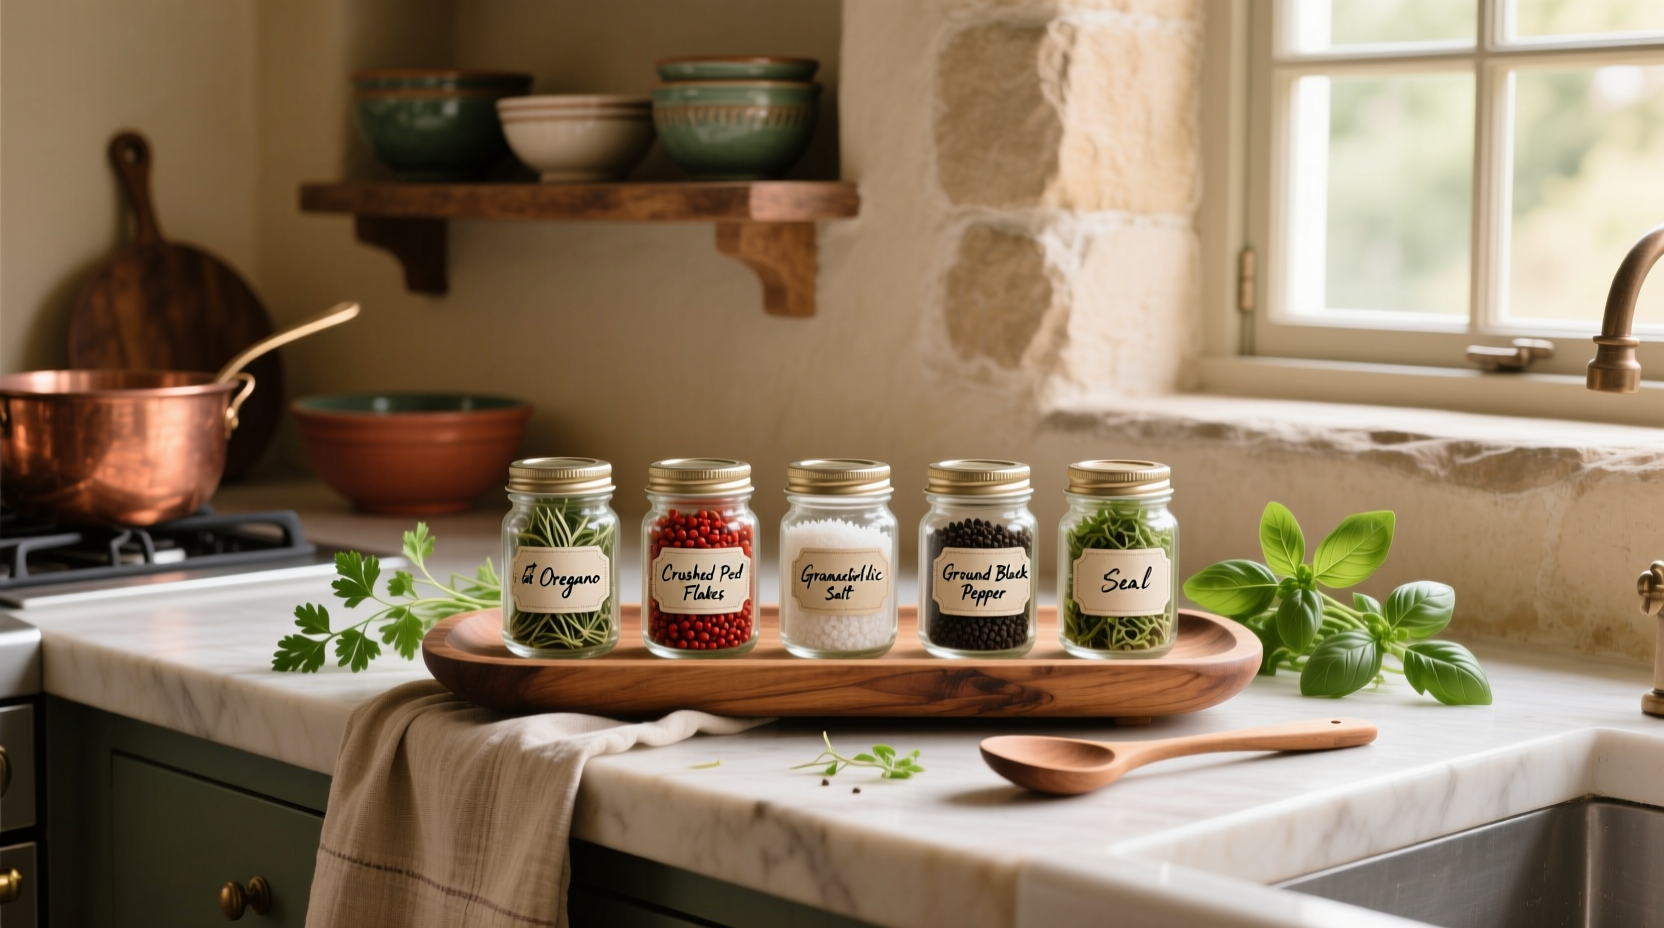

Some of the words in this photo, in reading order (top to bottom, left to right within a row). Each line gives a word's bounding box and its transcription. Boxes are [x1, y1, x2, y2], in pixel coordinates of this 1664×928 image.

[540, 567, 600, 599] Oregano
[661, 563, 716, 582] Crushed
[942, 563, 993, 582] Ground
[1101, 566, 1153, 593] Seal
[825, 585, 855, 601] Salt
[961, 583, 1007, 607] Pepper
